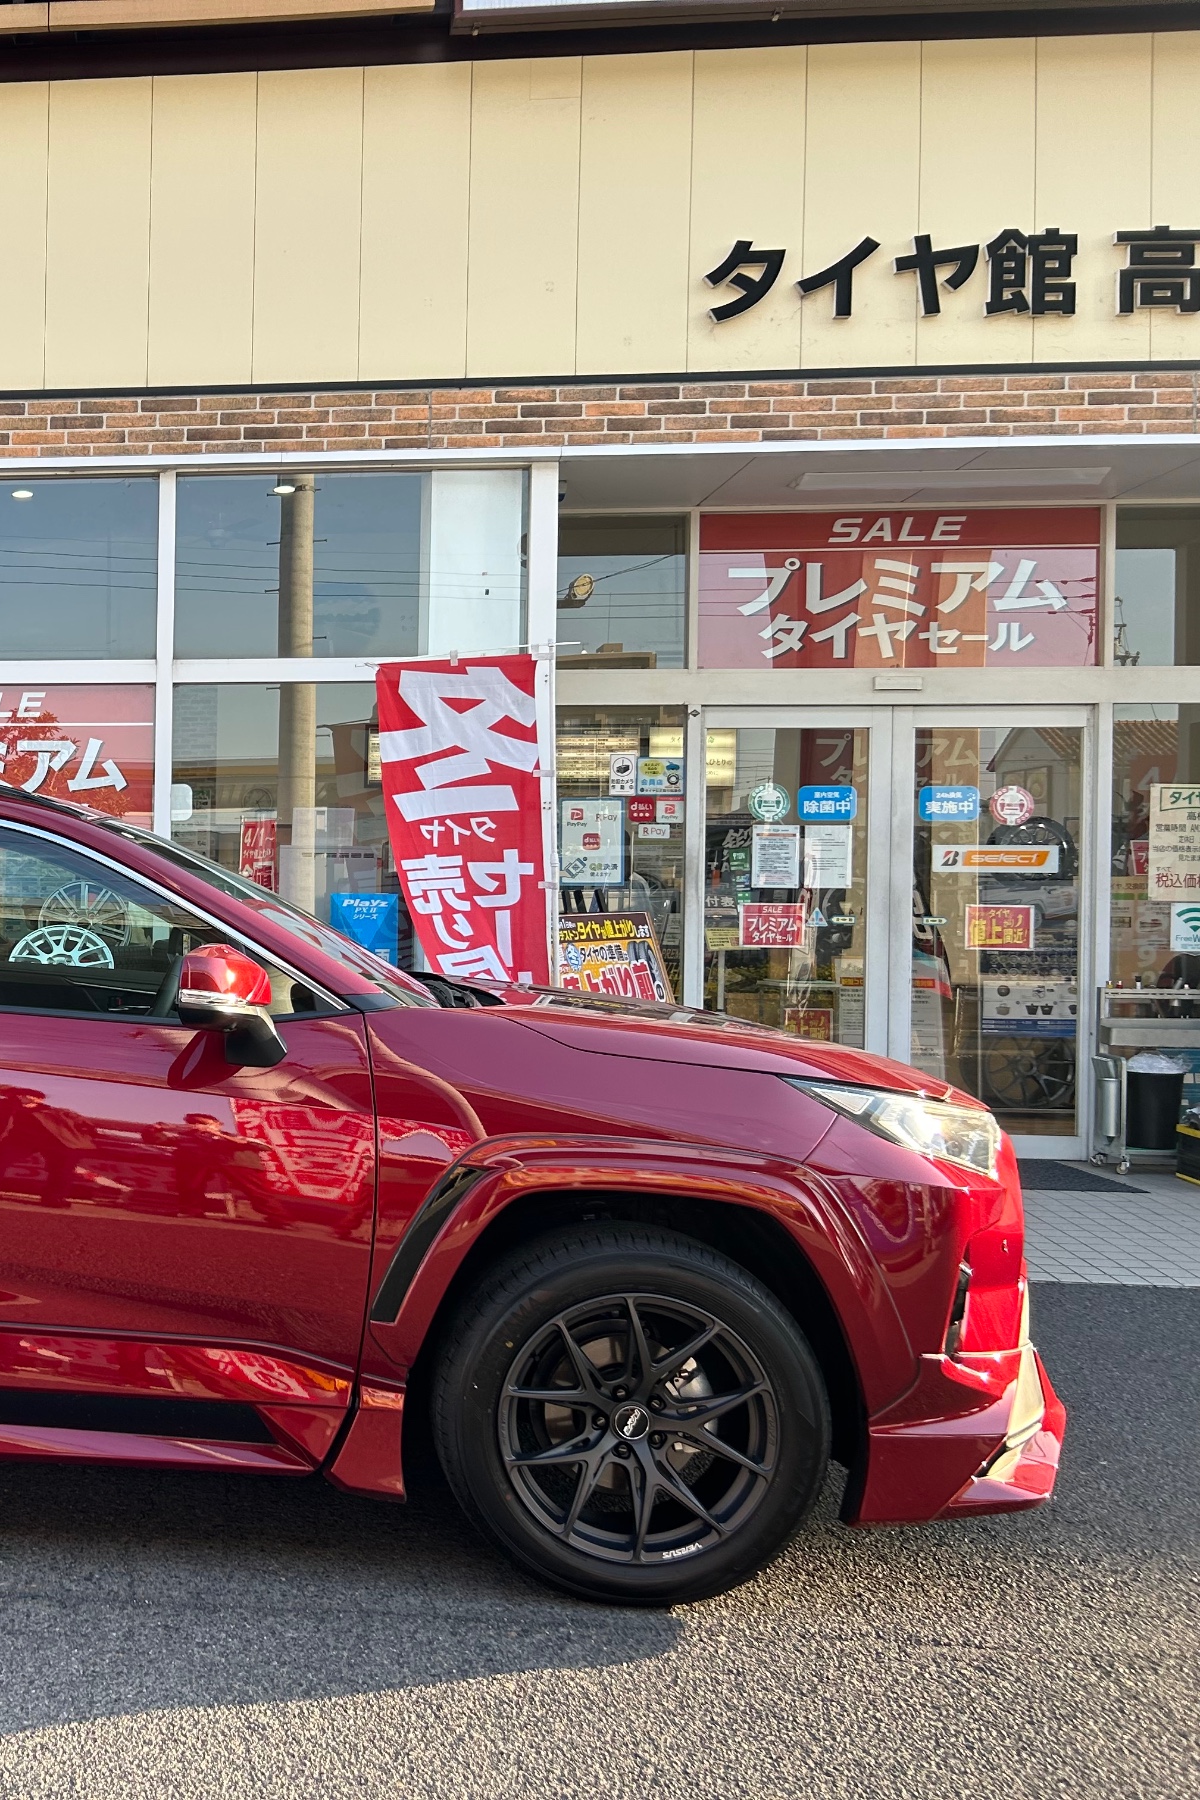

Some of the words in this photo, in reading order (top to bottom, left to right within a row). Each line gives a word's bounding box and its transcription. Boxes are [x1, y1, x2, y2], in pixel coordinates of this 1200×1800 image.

[703, 227, 1078, 324] タイヤ館
[1112, 226, 1200, 317] 高
[828, 516, 967, 543] SALE
[728, 557, 1069, 617] プレミアム
[758, 612, 1036, 660] タイヤセール
[803, 800, 851, 814] 除菌中
[925, 801, 974, 814] 実施中
[1187, 811, 1200, 820] 高
[1155, 873, 1200, 888] 税込価
[342, 899, 388, 907] Playz
[747, 916, 798, 932] プレミアム
[752, 931, 793, 943] タイヤセール
[662, 1542, 703, 1559] VERSUS
